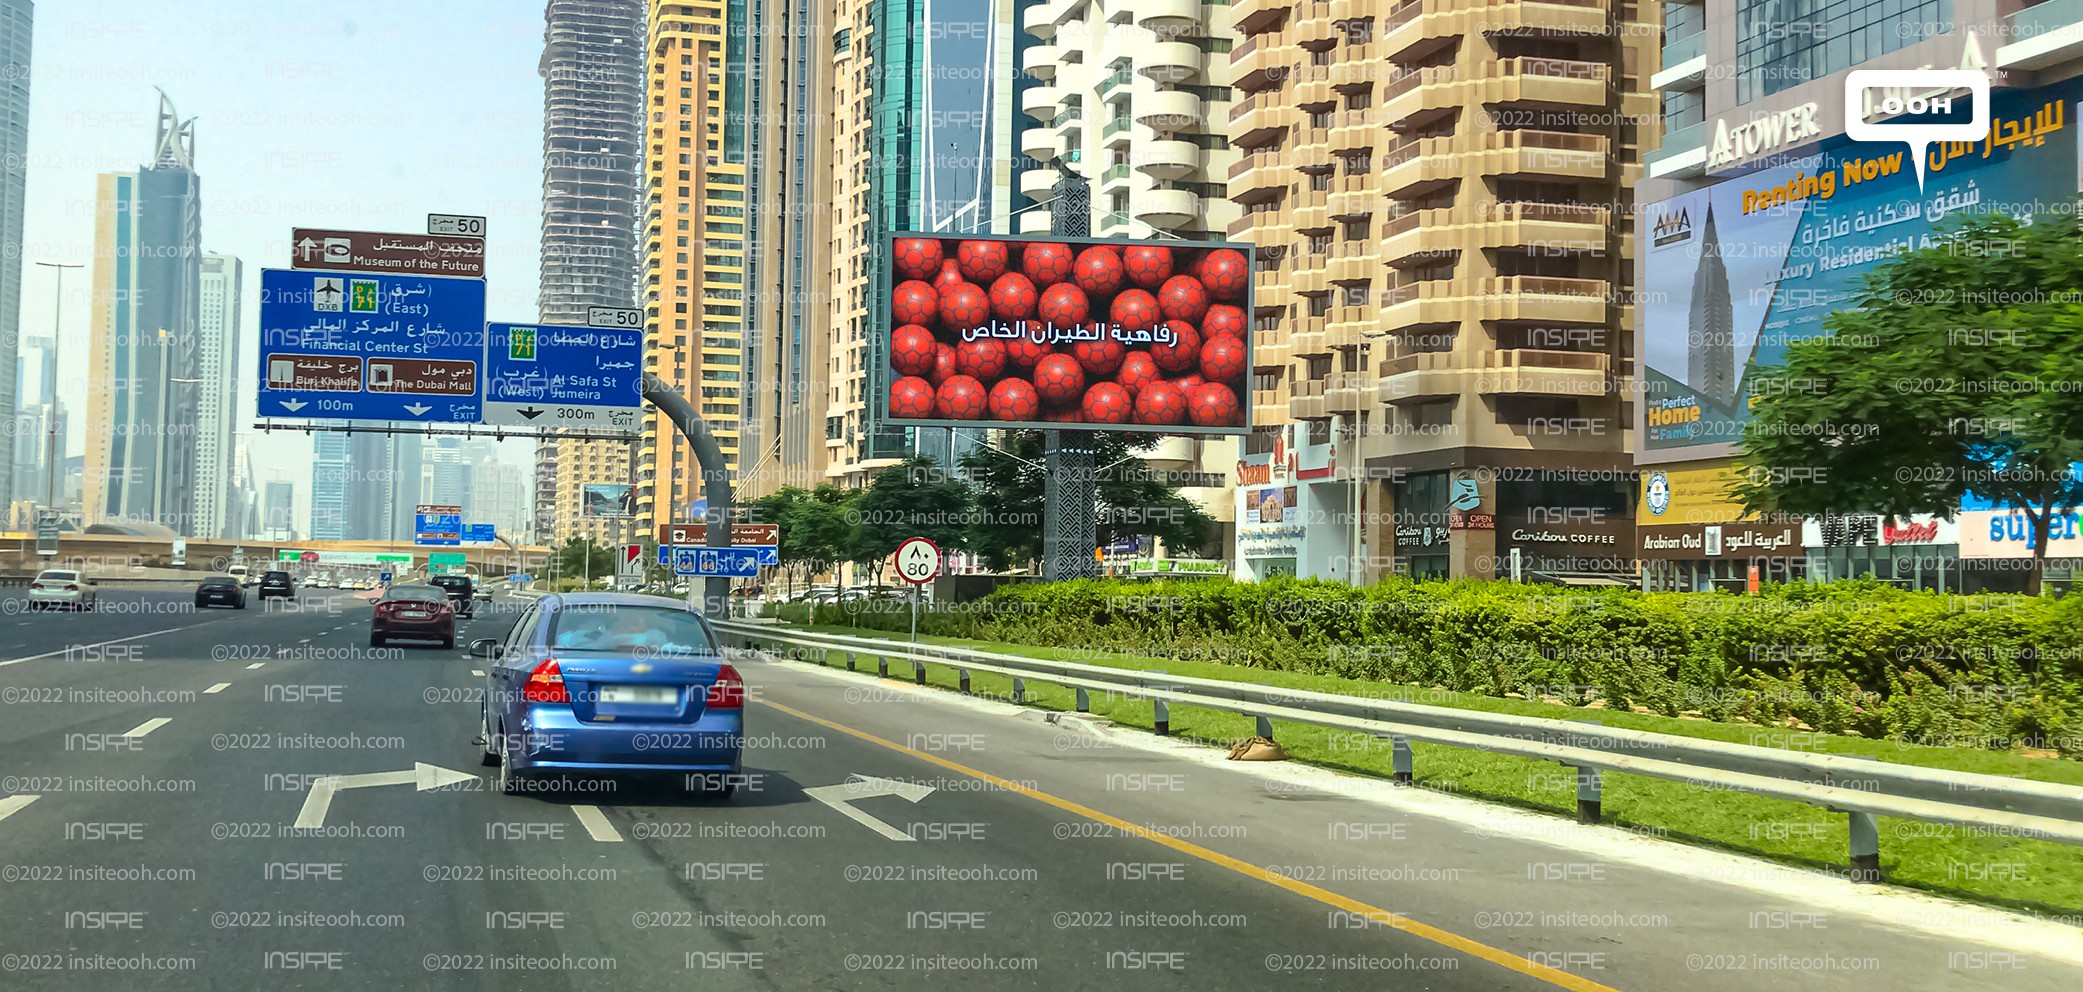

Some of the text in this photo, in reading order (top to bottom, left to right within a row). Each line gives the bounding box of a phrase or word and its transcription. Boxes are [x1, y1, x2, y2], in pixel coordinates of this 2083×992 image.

[1741, 151, 1903, 216] Renting Now
[1802, 179, 1980, 250] شقق سكنية فاخرة
[432, 218, 454, 226] مخرج
[457, 219, 480, 233] 50
[372, 238, 482, 254] متحف المستقبل
[353, 256, 479, 272] Museum of the Future
[1764, 261, 1816, 285] Luxury
[318, 303, 338, 311] DXB
[356, 296, 373, 309] 71
[384, 303, 429, 317] (East)
[616, 311, 638, 325] 50
[304, 318, 446, 337] شارع المركز المالي
[962, 319, 1178, 348] رفاهية الطيران الخاص
[301, 338, 429, 354] Financial Center St
[600, 335, 636, 349] شارع
[516, 344, 531, 356] 71
[297, 359, 360, 373] برج خليفة
[596, 355, 635, 371] جميرا
[421, 364, 473, 378] دبي مول
[296, 375, 358, 387] Burj Khalifa
[395, 379, 472, 391] The Dubai Mall
[552, 374, 617, 388] Al Safa St
[498, 385, 545, 400] (West)
[552, 388, 601, 400] Jumeira
[317, 399, 354, 411] 100m
[449, 403, 476, 412] مخرج
[1662, 394, 1696, 409] Perfect
[453, 412, 475, 420] EXIT
[557, 408, 595, 420] 300m
[608, 410, 634, 418] مخرج
[1648, 405, 1701, 427] Home
[612, 418, 634, 426] EXIT
[1660, 424, 1696, 440] Family
[1470, 514, 1492, 523] OPEN
[1395, 525, 1422, 537] Caribou
[1511, 528, 1615, 544] Caribou COFFEE
[1820, 516, 1879, 548] VAPE
[1989, 512, 2083, 550] super
[1397, 537, 1420, 546] COFFEE
[1643, 532, 1702, 550] Arabian Oud
[1725, 529, 1792, 552] العربية للعود
[907, 562, 929, 576] 80
